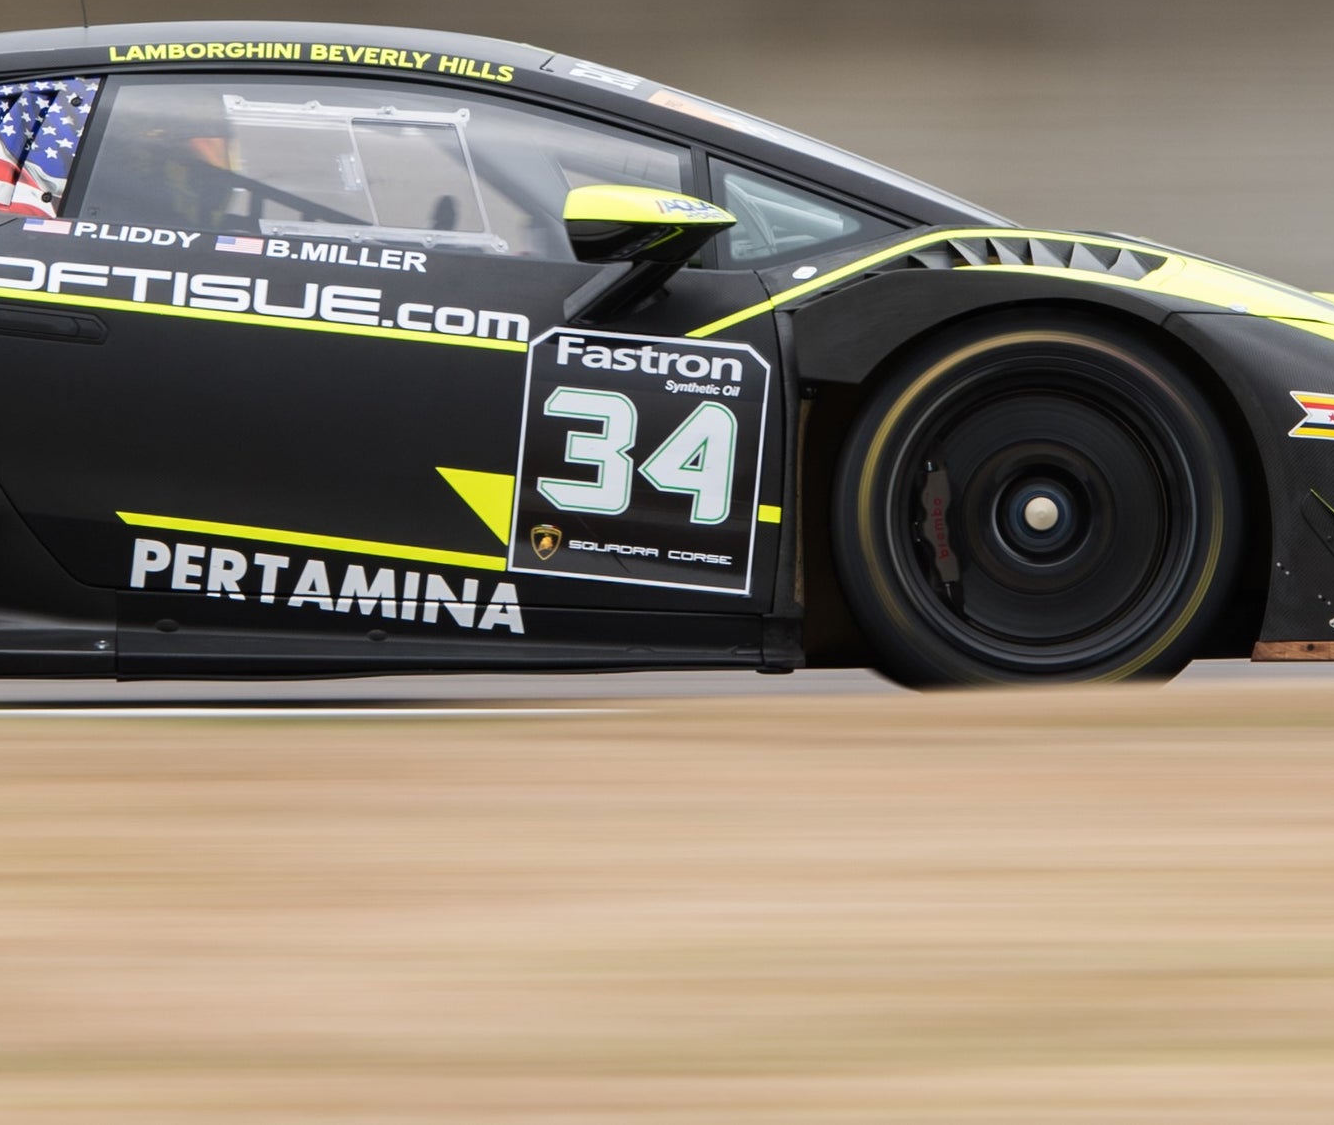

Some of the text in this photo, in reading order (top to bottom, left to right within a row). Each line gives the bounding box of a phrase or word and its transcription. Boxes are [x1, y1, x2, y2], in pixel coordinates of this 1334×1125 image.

[109, 42, 515, 83] LAMBORGHINI BEVERLY HILLS
[74, 222, 427, 273] P.LIDDY B.MILLER
[556, 335, 743, 382] Fastron
[665, 380, 741, 398] Synthetic Oil
[536, 386, 738, 525] 34
[568, 539, 732, 565] SQUADRA CORSE
[130, 537, 525, 634] PERTAMINA
